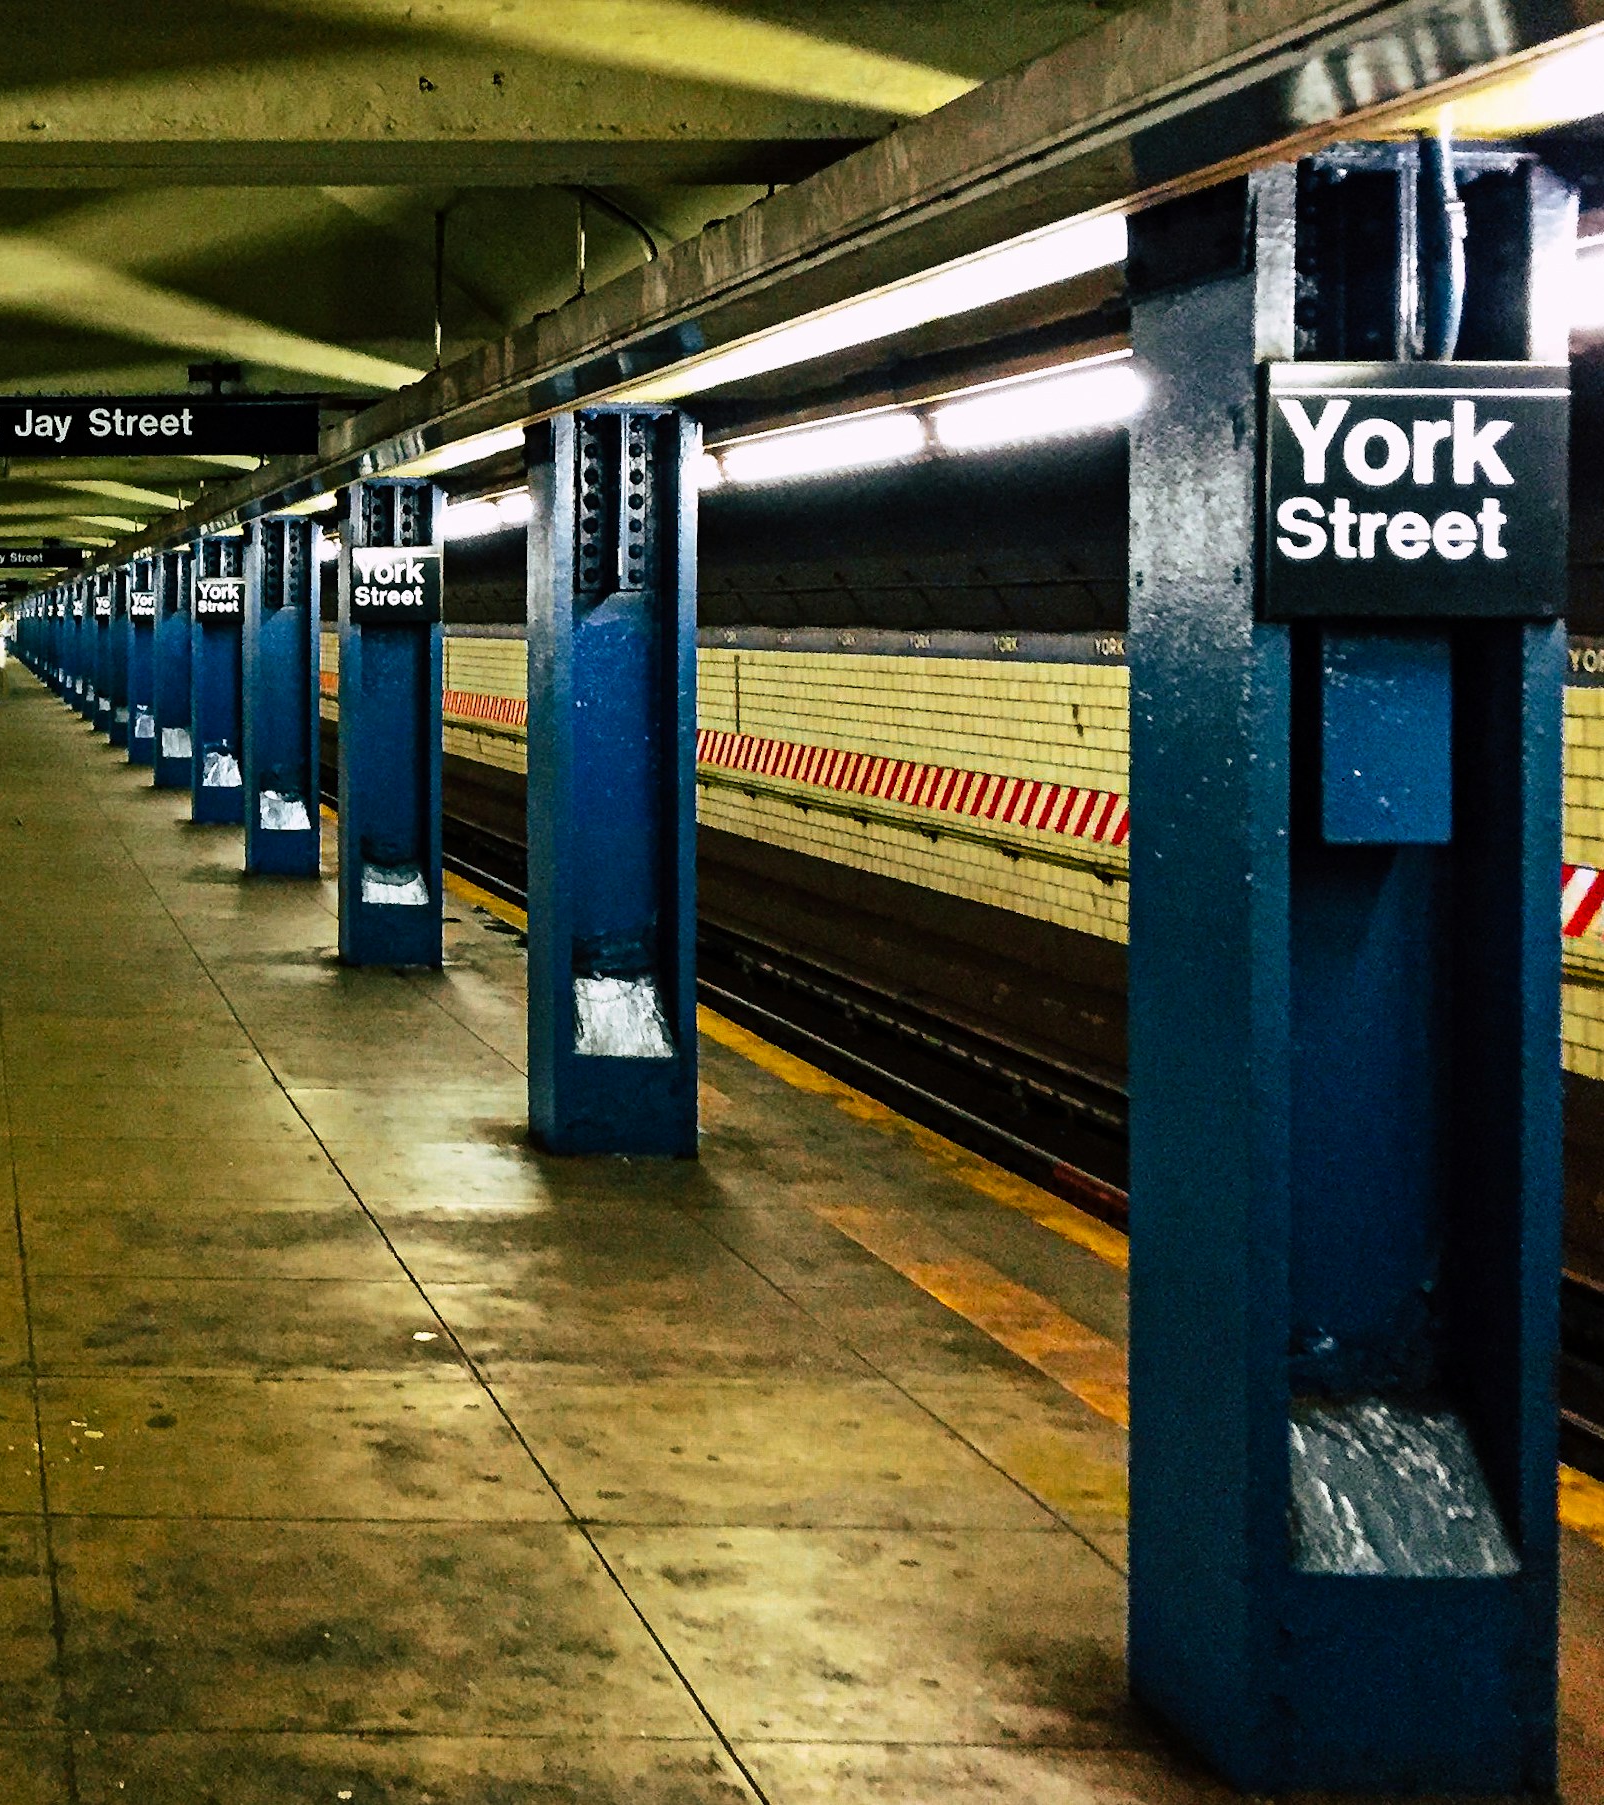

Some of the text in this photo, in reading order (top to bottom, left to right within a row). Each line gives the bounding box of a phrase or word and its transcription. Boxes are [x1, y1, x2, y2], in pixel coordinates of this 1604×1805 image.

[14, 409, 72, 443] Jay
[88, 408, 194, 437] Street
[1276, 399, 1515, 487] York
[1276, 496, 1509, 561] Street
[10, 551, 44, 563] Street
[354, 556, 426, 585] York
[131, 592, 155, 606] Yor
[197, 581, 240, 600] York
[354, 585, 424, 607] Street
[197, 600, 240, 614] Street
[1095, 637, 1125, 657] YORK
